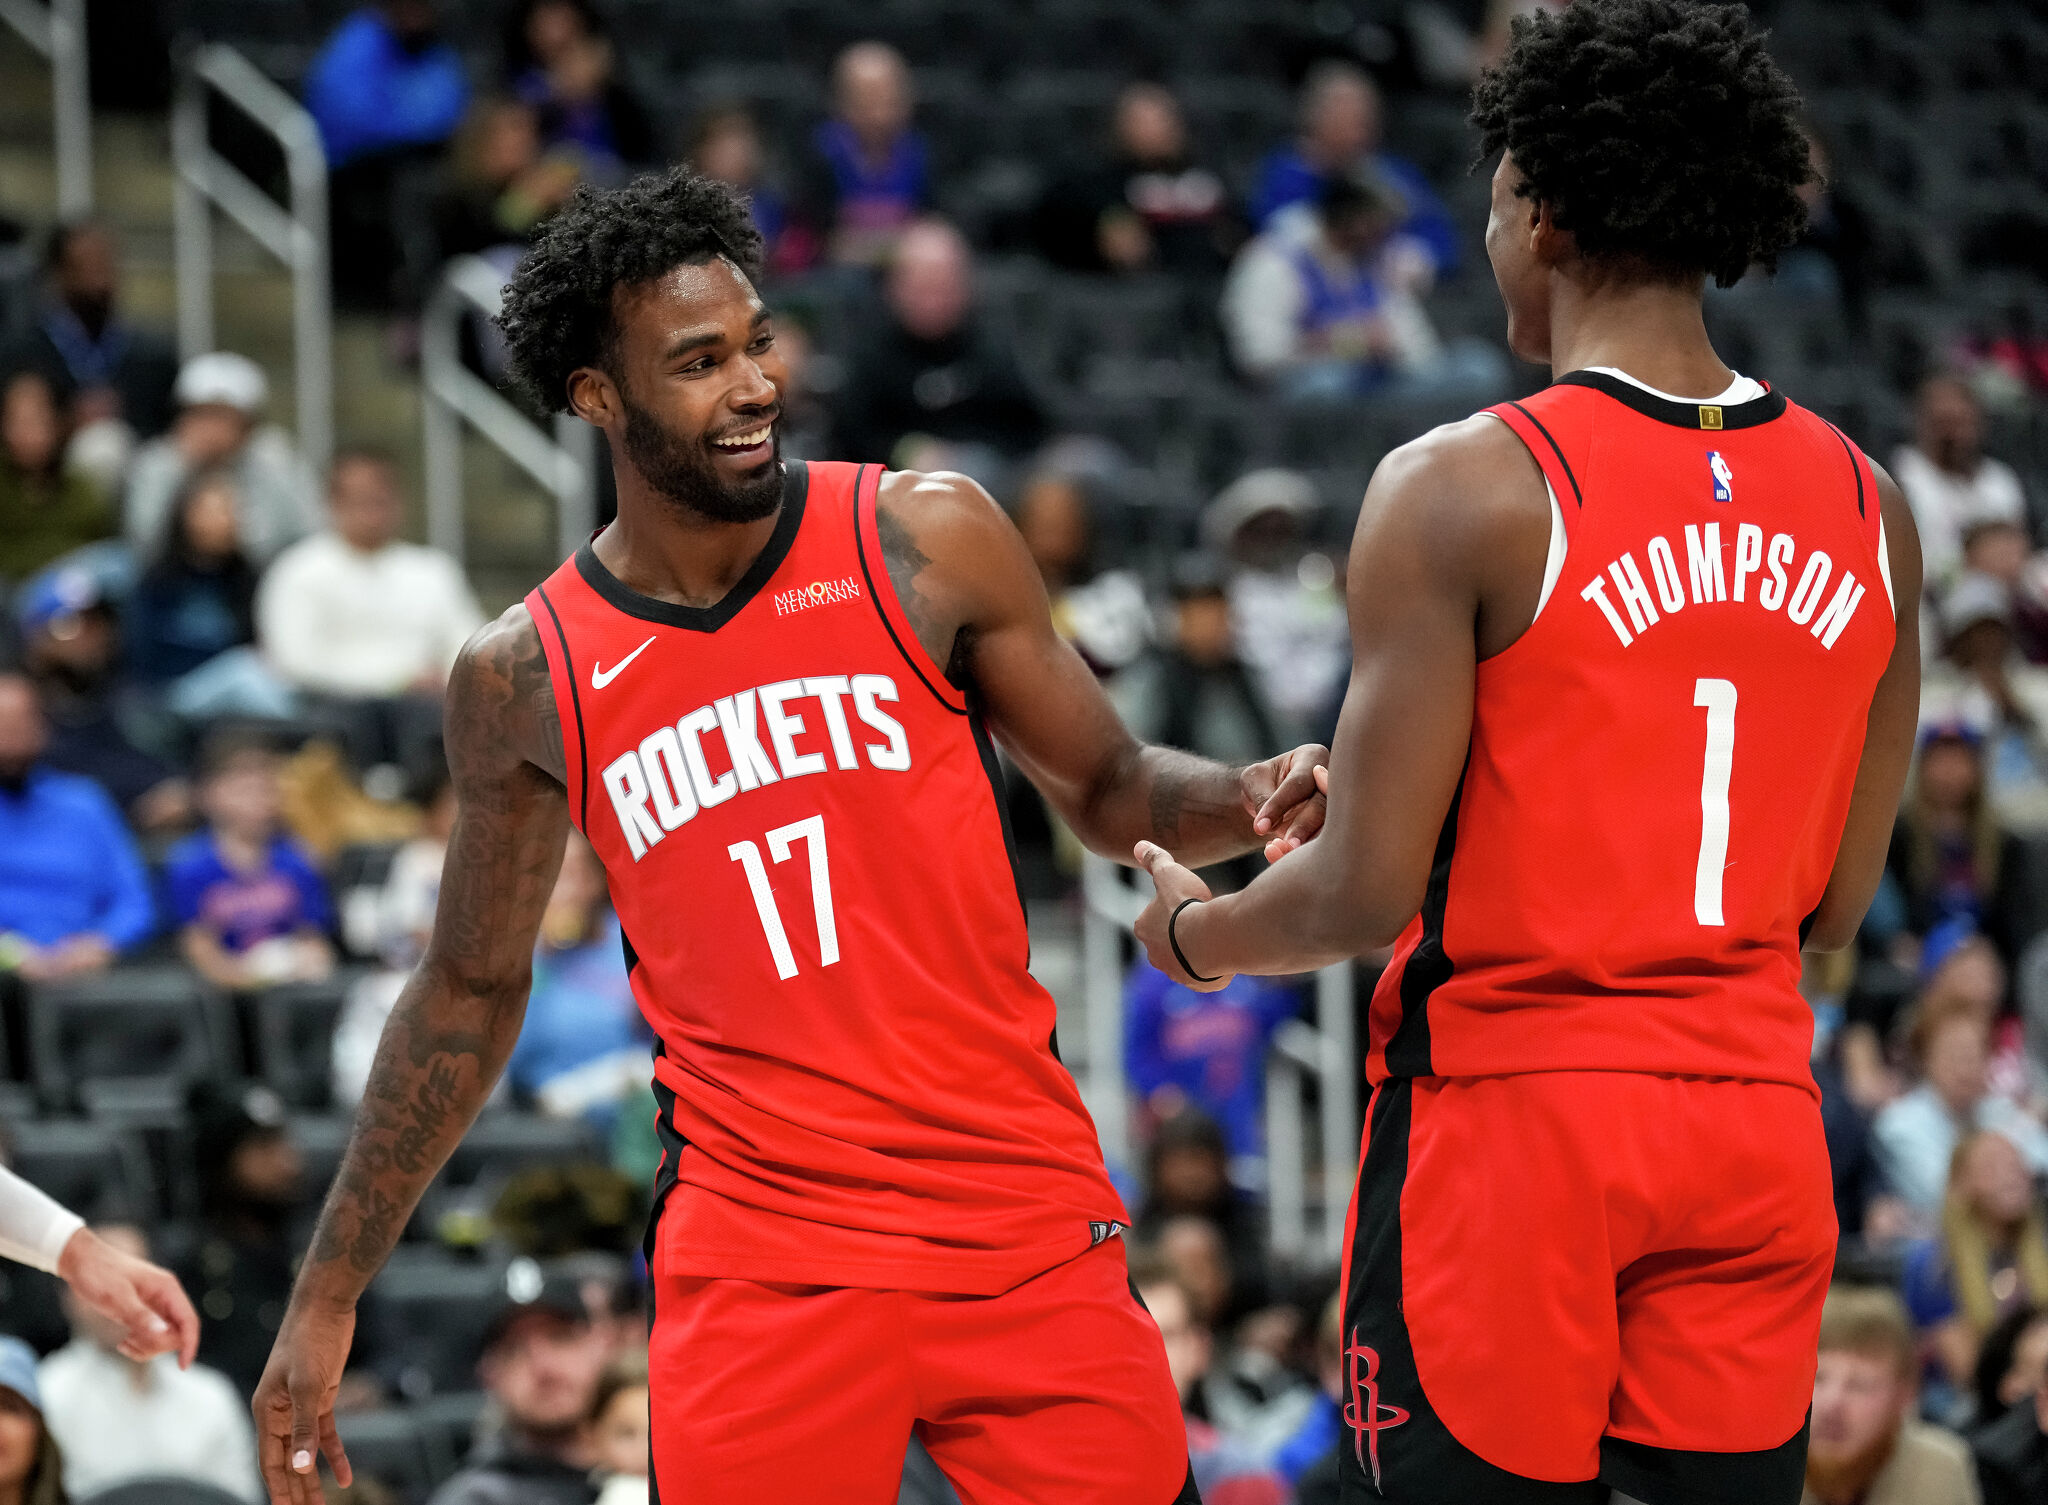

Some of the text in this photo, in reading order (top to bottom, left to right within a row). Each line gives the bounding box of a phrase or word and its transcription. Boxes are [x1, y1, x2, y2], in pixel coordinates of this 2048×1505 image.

[1716, 489, 1728, 500] NBA
[774, 577, 858, 605] MEMORIAL
[776, 586, 860, 616] HERMANN
[1580, 522, 1866, 651] THOMPSON
[602, 674, 911, 863] ROCKETS
[1694, 678, 1738, 926] 1
[727, 814, 840, 981] 17
